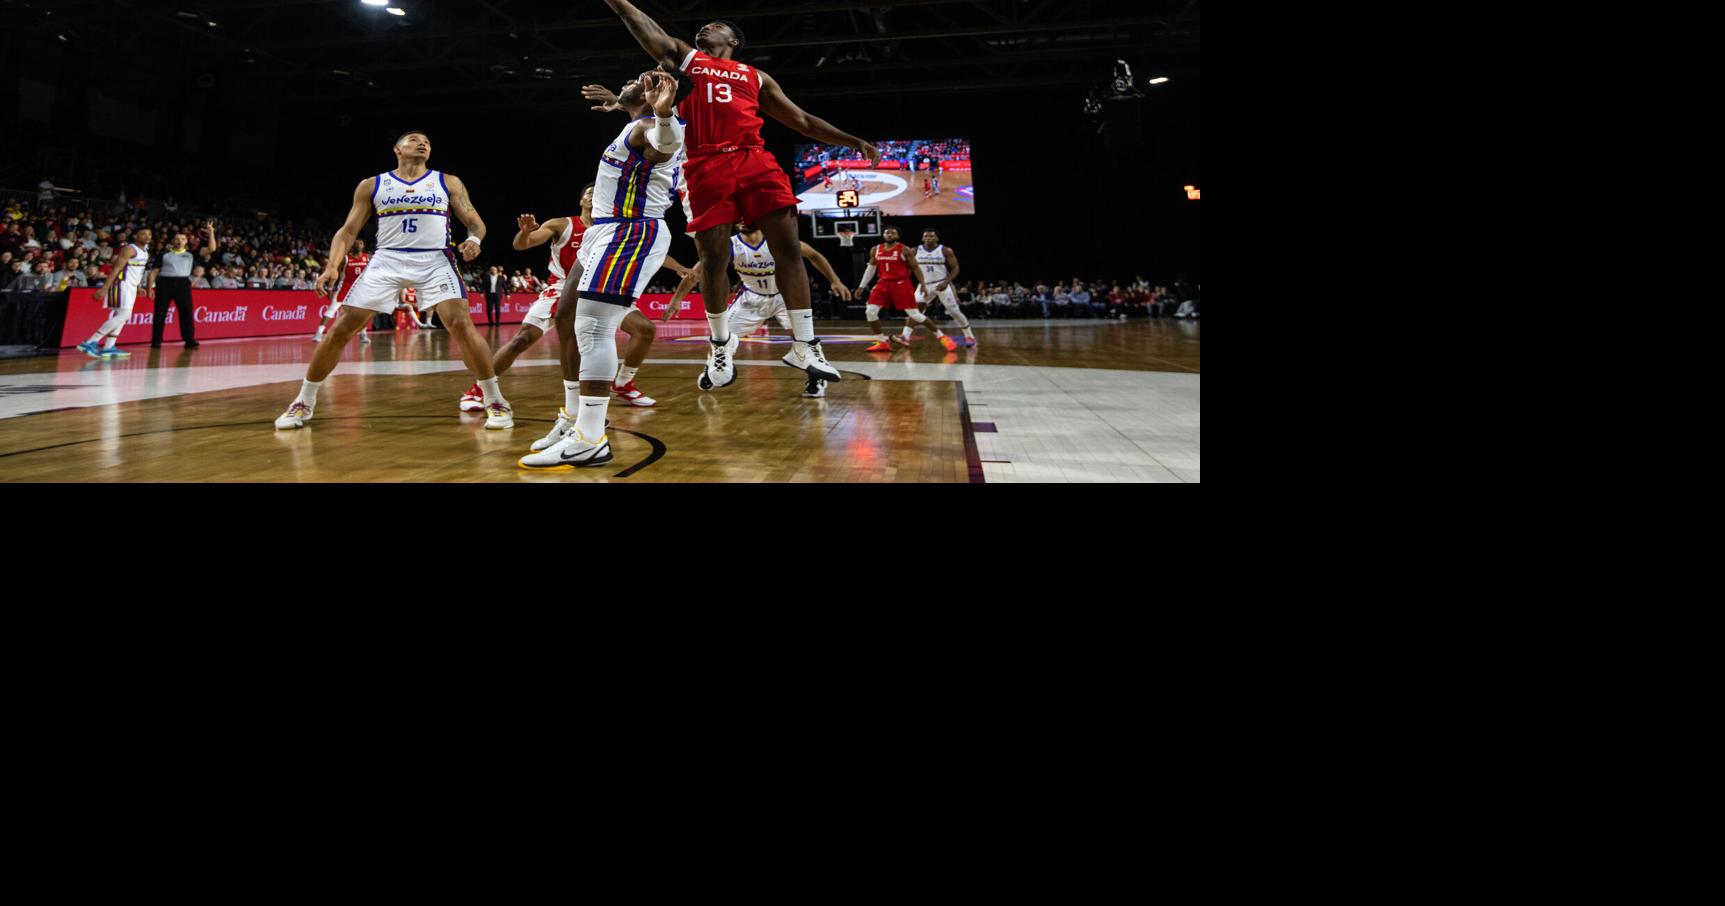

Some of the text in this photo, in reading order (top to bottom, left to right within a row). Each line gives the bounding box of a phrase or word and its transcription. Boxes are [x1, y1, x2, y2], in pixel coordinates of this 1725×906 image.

[691, 66, 748, 82] CANADA
[707, 82, 733, 103] 13
[402, 219, 418, 233] 15
[757, 279, 768, 288] 11
[193, 305, 247, 323] Canada
[262, 305, 307, 320] Canada
